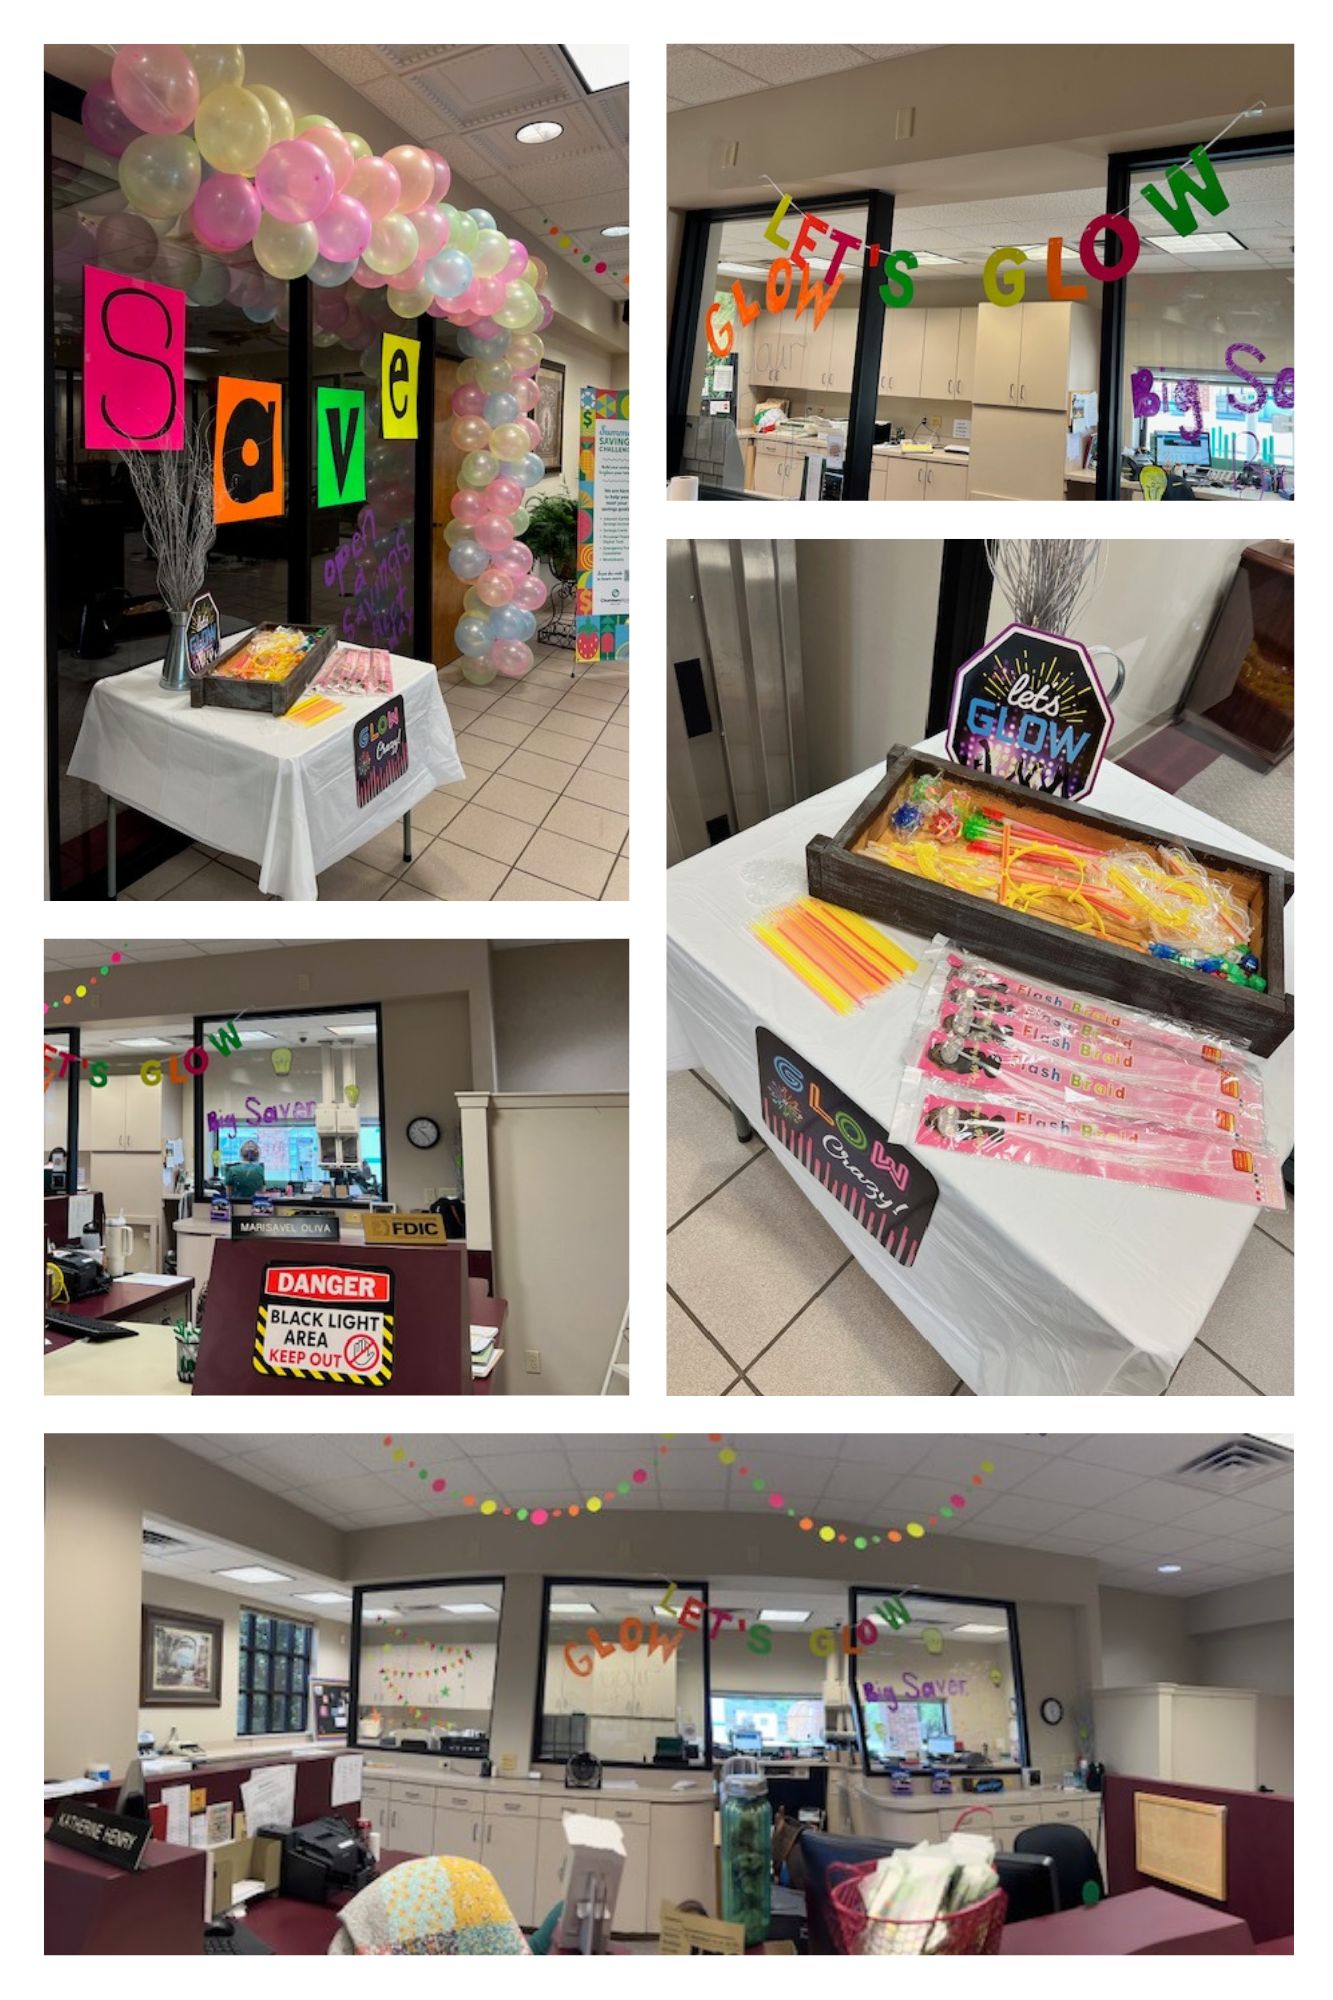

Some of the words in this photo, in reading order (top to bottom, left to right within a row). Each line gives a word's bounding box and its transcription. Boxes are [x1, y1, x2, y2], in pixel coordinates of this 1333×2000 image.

[763, 193, 919, 308] LET'S
[983, 144, 1230, 307] GLOW
[705, 257, 845, 357] GLOW
[1130, 367, 1203, 441] Big
[1007, 673, 1061, 716] lets
[359, 706, 399, 748] GLOW
[966, 697, 1091, 764] GLOW
[140, 1020, 243, 1086] GLOW
[1023, 1025, 1071, 1050] Flash
[1081, 1043, 1132, 1067] Braid
[1070, 1073, 1126, 1099] Braid
[207, 1109, 237, 1139] Big
[245, 1096, 316, 1126] Saver
[773, 1056, 909, 1192] GLOW
[1016, 1112, 1070, 1136] Flash
[822, 1133, 910, 1216] Crazy!
[240, 1222, 297, 1233] MARISAVEL
[301, 1223, 331, 1233] OLIVA
[392, 1222, 439, 1236] FDIC
[277, 1271, 376, 1298] DANGER
[271, 1309, 324, 1328] BLACK
[328, 1313, 380, 1332] LIGHT
[283, 1329, 328, 1348] AREA
[269, 1348, 306, 1364] KEEP
[309, 1352, 342, 1368] OUT
[658, 1582, 773, 1655] LET'S
[808, 1595, 913, 1657] GLOW
[562, 1616, 685, 1678] GLOW
[863, 1681, 898, 1713] Big
